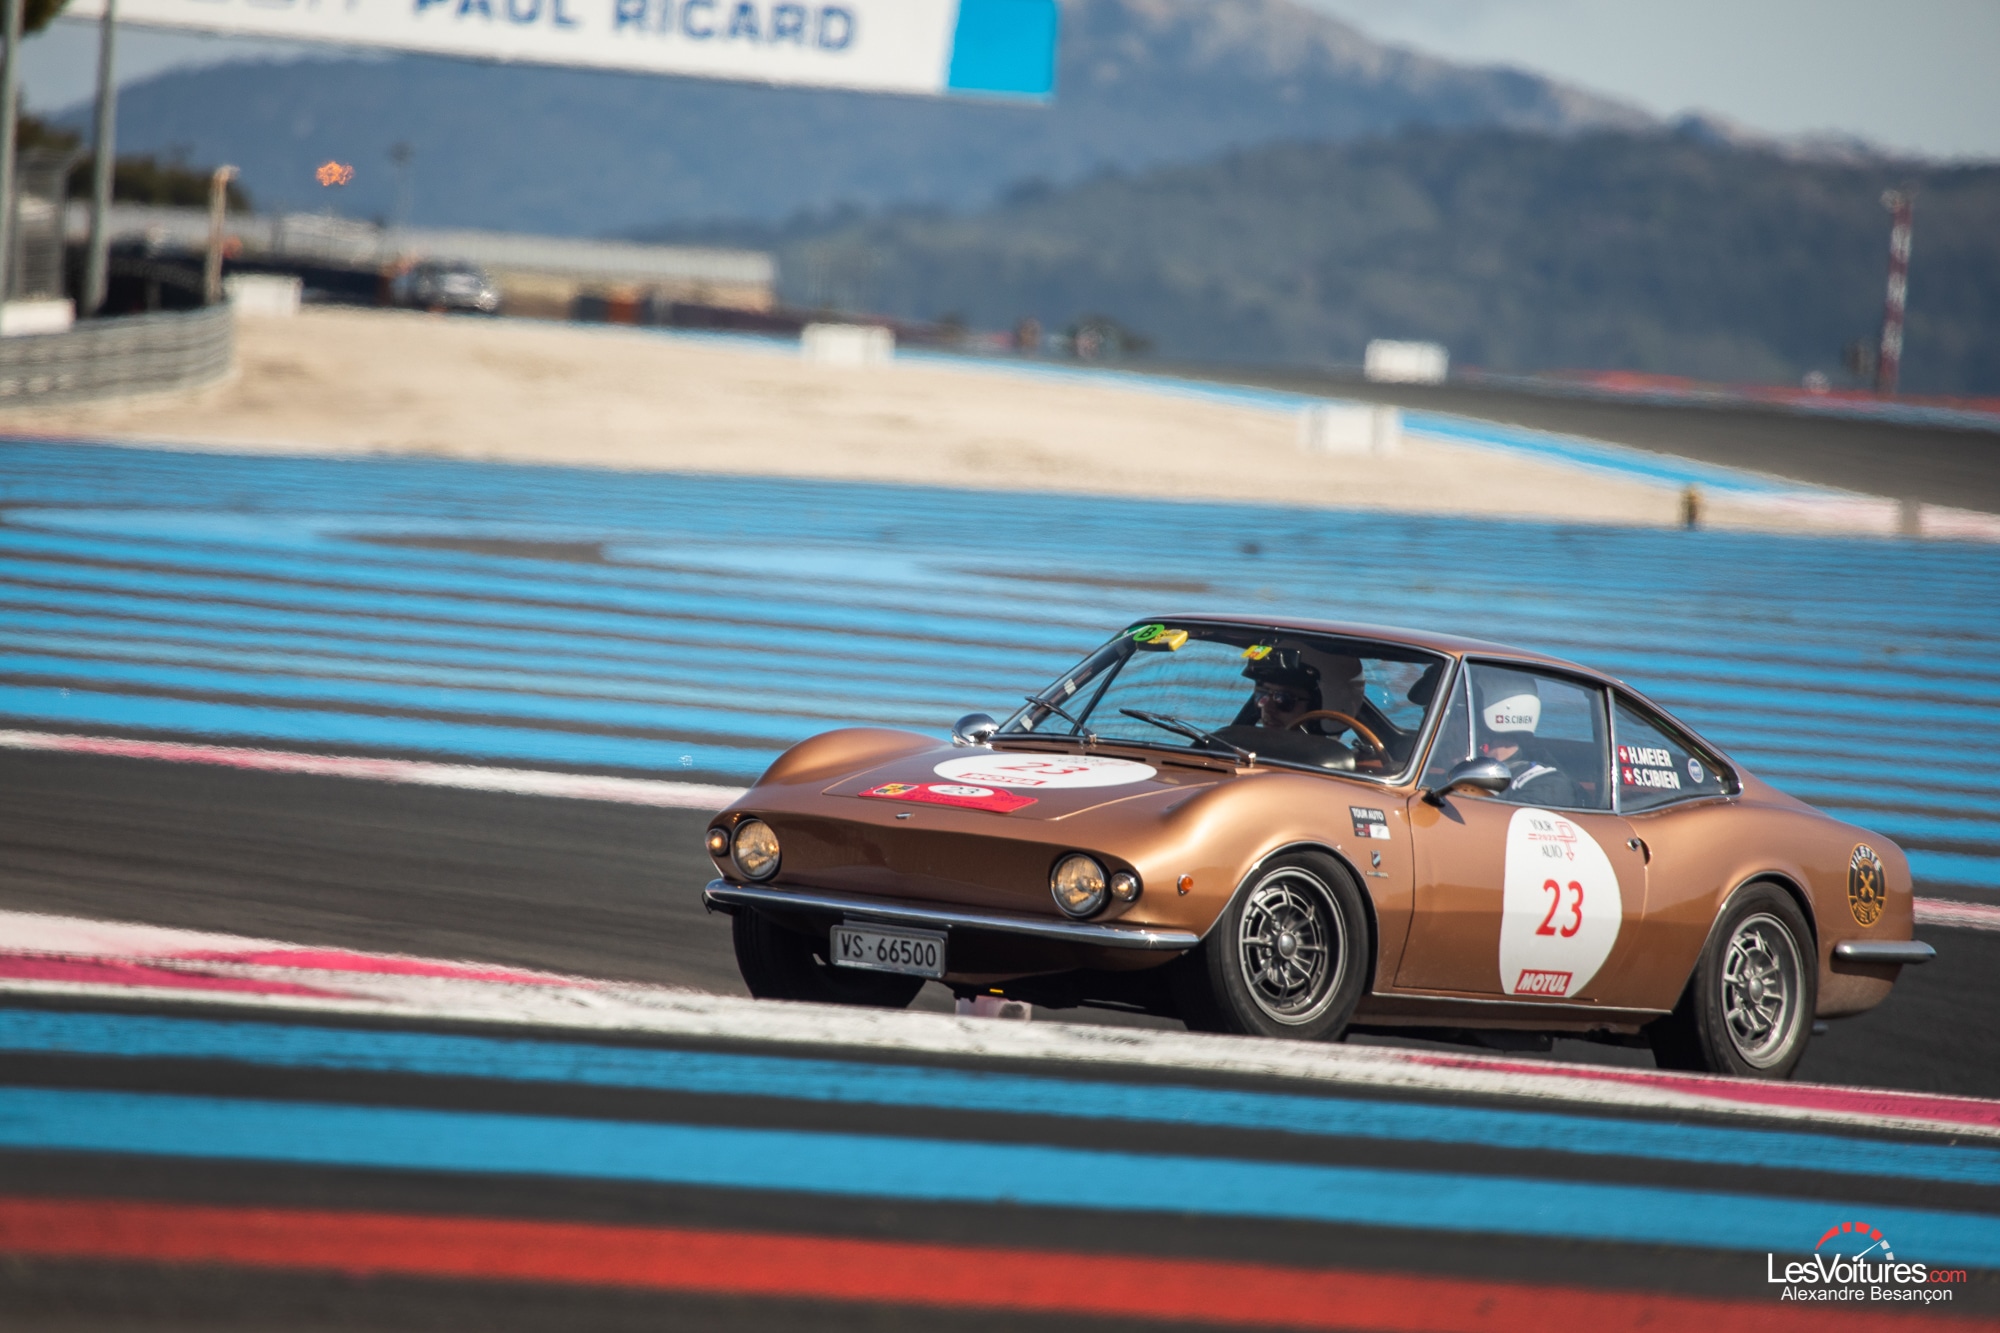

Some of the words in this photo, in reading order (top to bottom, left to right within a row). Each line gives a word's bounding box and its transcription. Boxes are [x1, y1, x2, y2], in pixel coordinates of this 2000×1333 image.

[612, 0, 854, 51] RICARD
[1626, 746, 1674, 768] H.MEIER
[1632, 767, 1681, 790] S.CIBIEN
[1351, 807, 1369, 819] TOUR
[1368, 809, 1385, 822] AUTO
[1529, 819, 1554, 831] TOUR
[1541, 844, 1563, 859] AUTO
[1535, 878, 1584, 938] 23
[1517, 972, 1568, 993] MOTUL
